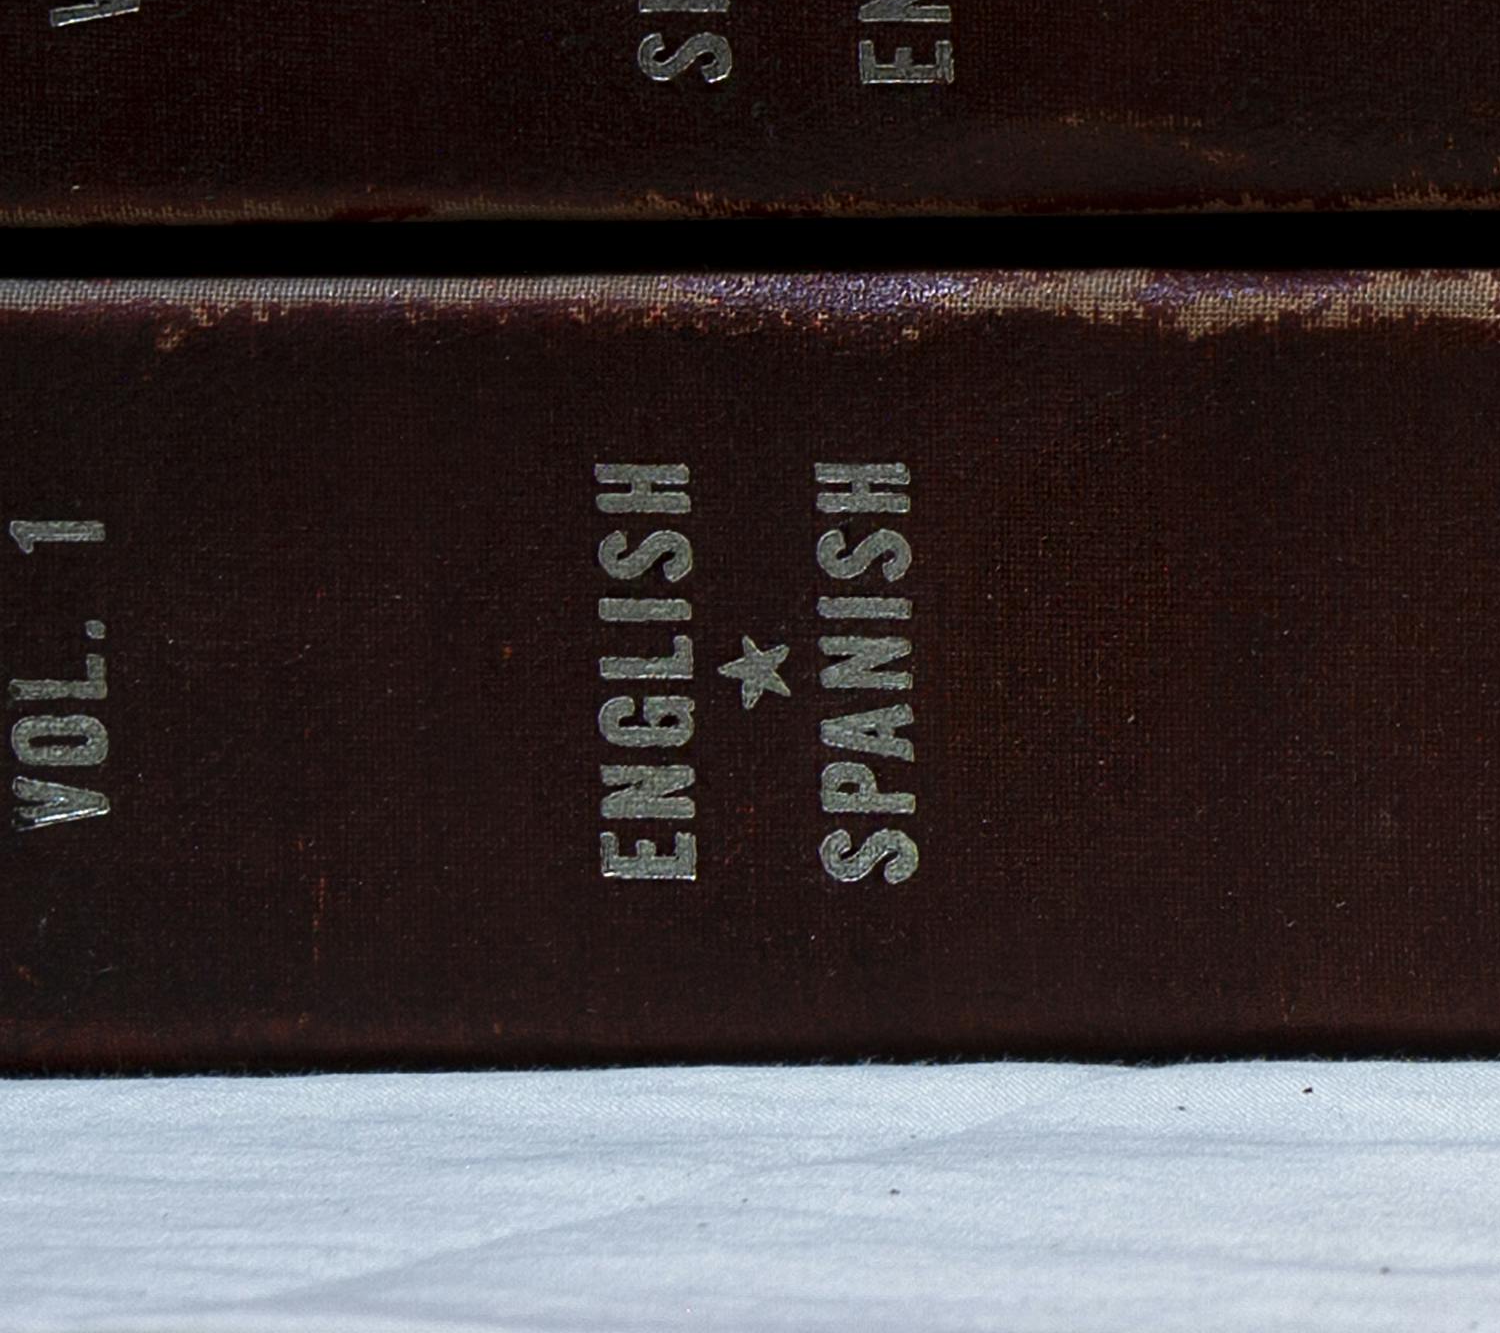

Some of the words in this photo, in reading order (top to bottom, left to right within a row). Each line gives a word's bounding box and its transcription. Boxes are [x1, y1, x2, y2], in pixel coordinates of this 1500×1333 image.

[9, 520, 106, 554] 1
[594, 462, 697, 881] ENGLISH
[813, 461, 919, 883] SPANISH
[8, 619, 110, 830] VOL.
